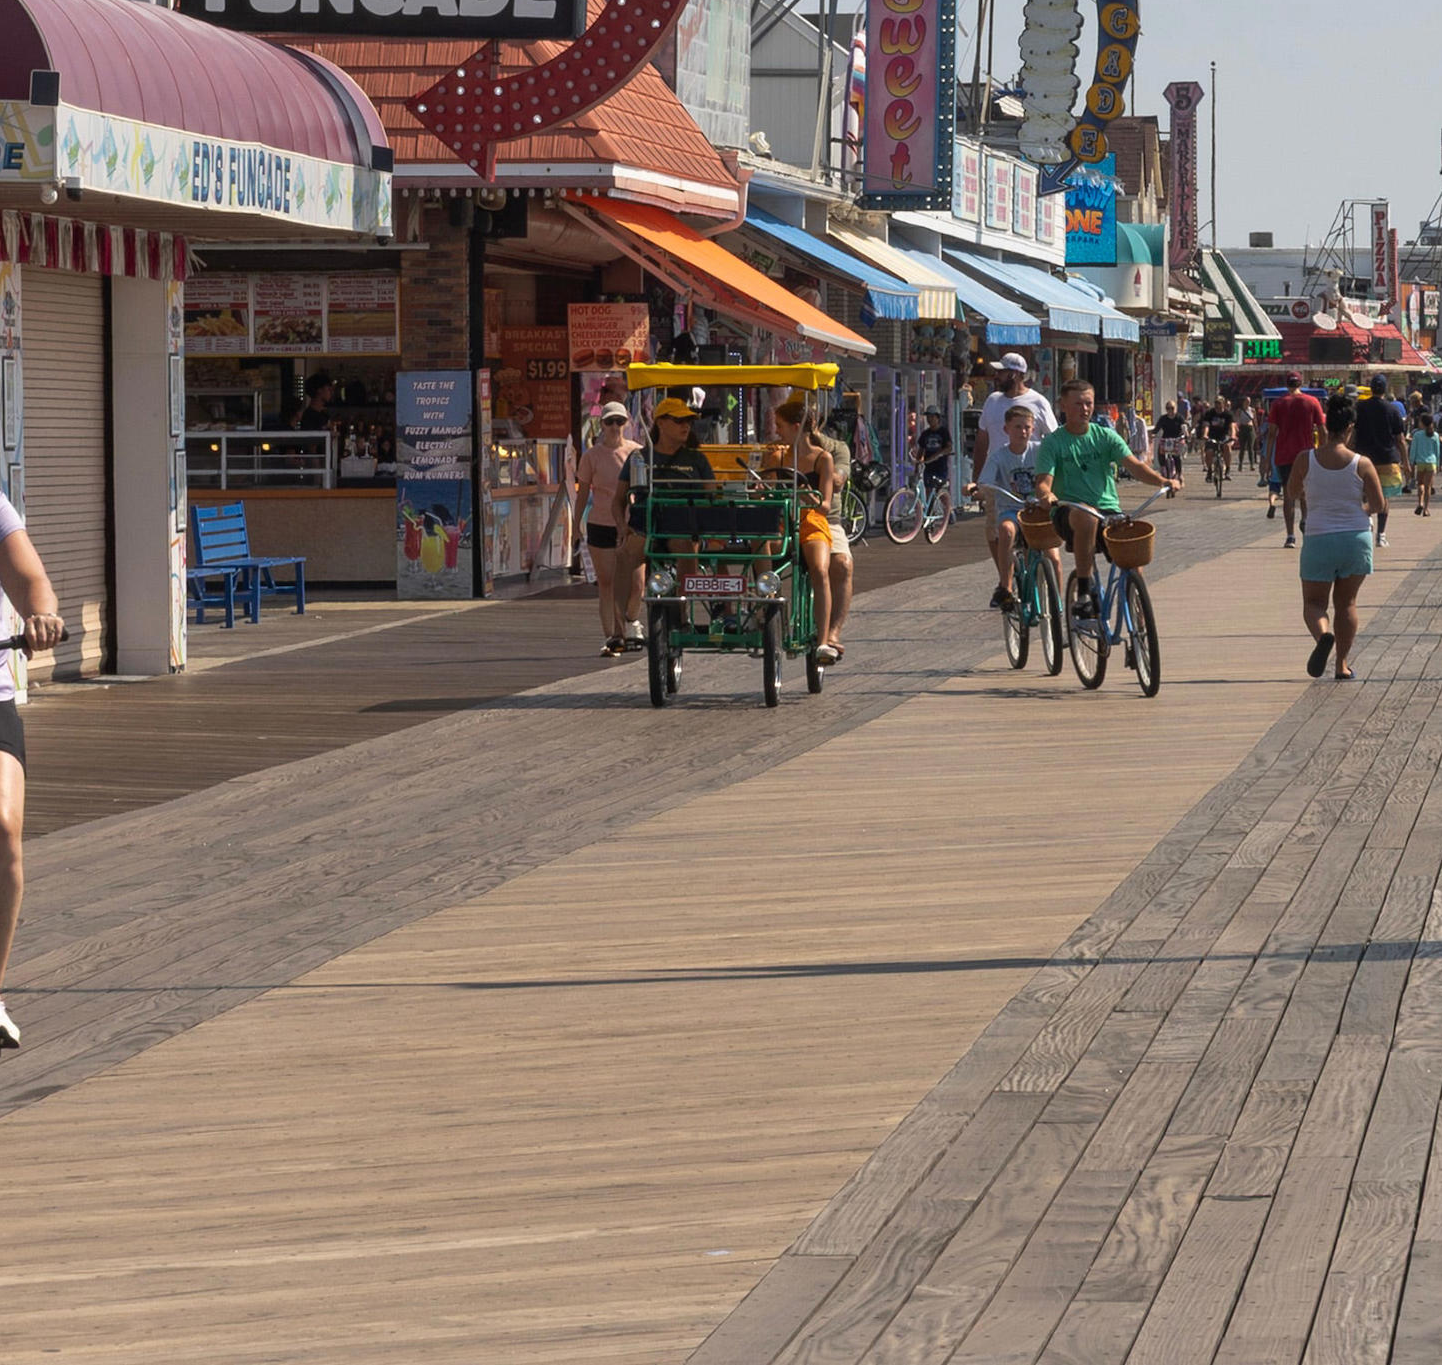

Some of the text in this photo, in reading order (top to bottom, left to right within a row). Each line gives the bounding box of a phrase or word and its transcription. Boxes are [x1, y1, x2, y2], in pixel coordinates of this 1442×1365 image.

[1174, 87, 1192, 110] 5
[192, 141, 291, 214] ED'S FUNCADE
[1065, 208, 1104, 235] ONE
[1374, 211, 1387, 287] PIZZA
[571, 305, 611, 316] HOT DOG
[571, 322, 618, 330] HAMBURGER
[504, 329, 568, 340] BREAKFAST
[514, 342, 560, 352] SPECIAL
[528, 360, 567, 378] $1.99
[413, 381, 455, 390] TASTE THE
[416, 397, 450, 405] TROPICS
[423, 412, 445, 420] WITH
[405, 426, 463, 435] FUZZY MANGO
[415, 441, 453, 450] ELECTRIC
[411, 456, 458, 465] LEMONADE
[404, 470, 464, 480] RUM RUNNERS
[685, 578, 744, 592] DEBBIE-1
